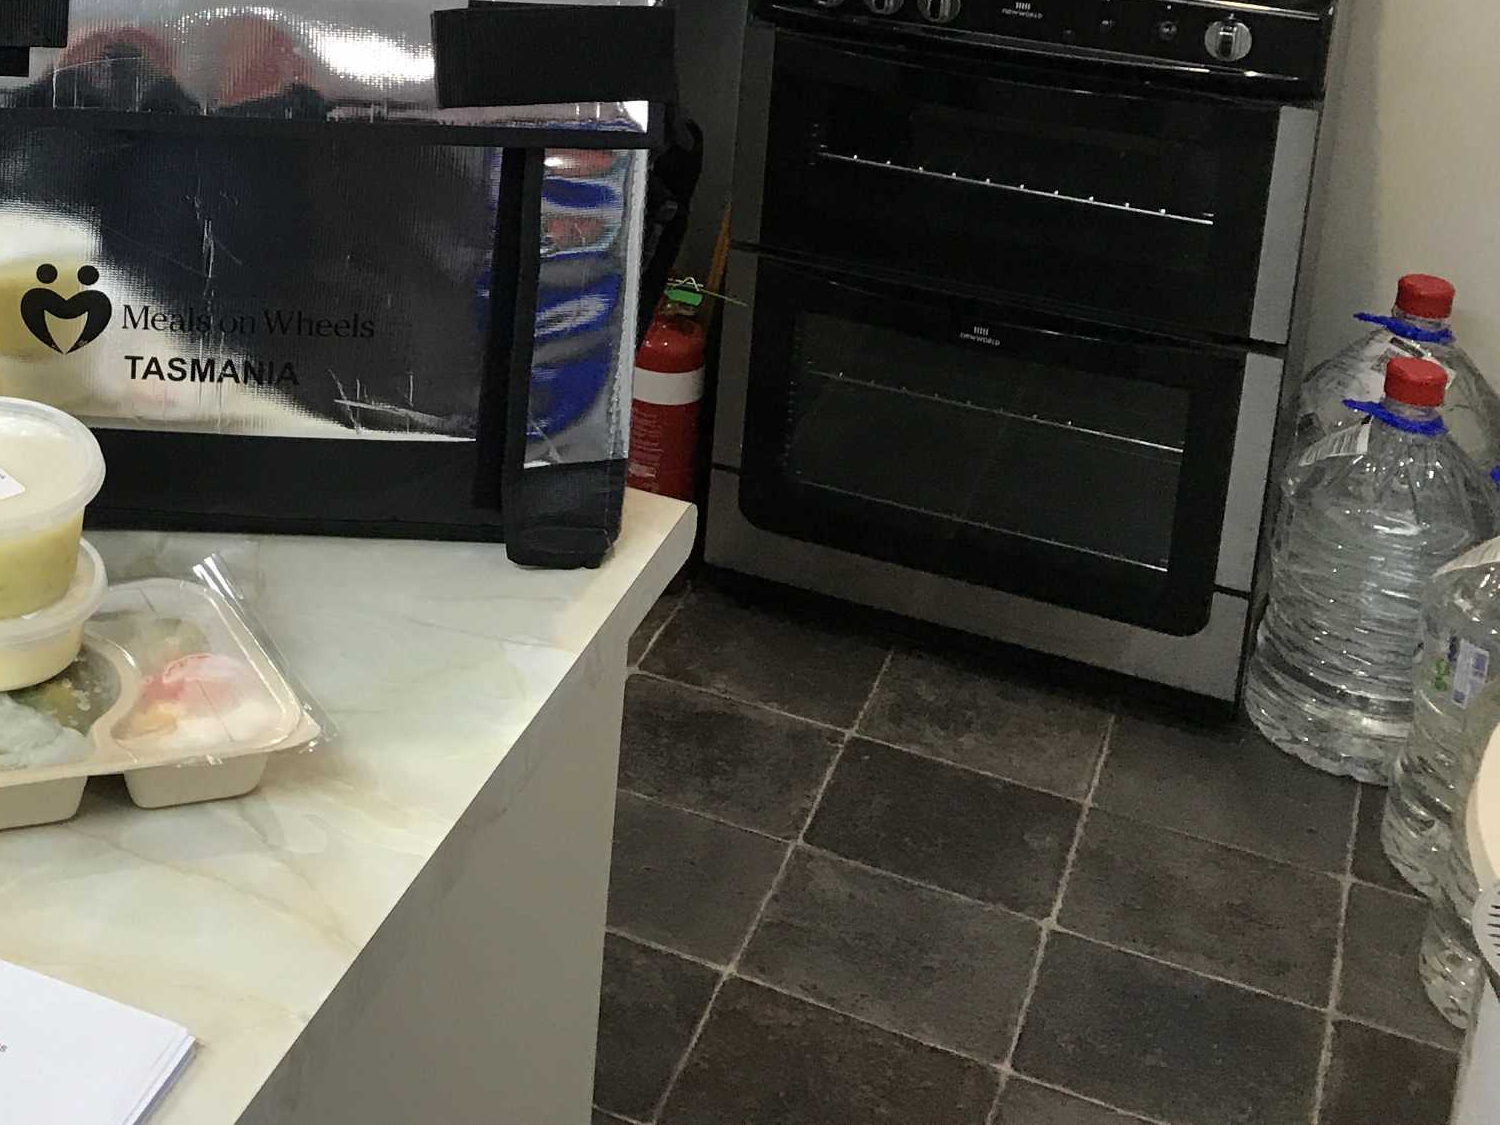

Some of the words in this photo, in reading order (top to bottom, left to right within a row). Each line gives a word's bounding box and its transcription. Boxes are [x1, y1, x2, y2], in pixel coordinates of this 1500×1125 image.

[121, 304, 212, 333] Meals
[221, 315, 255, 334] on
[261, 308, 375, 338] Wheels
[124, 355, 299, 386] TASMANIA
